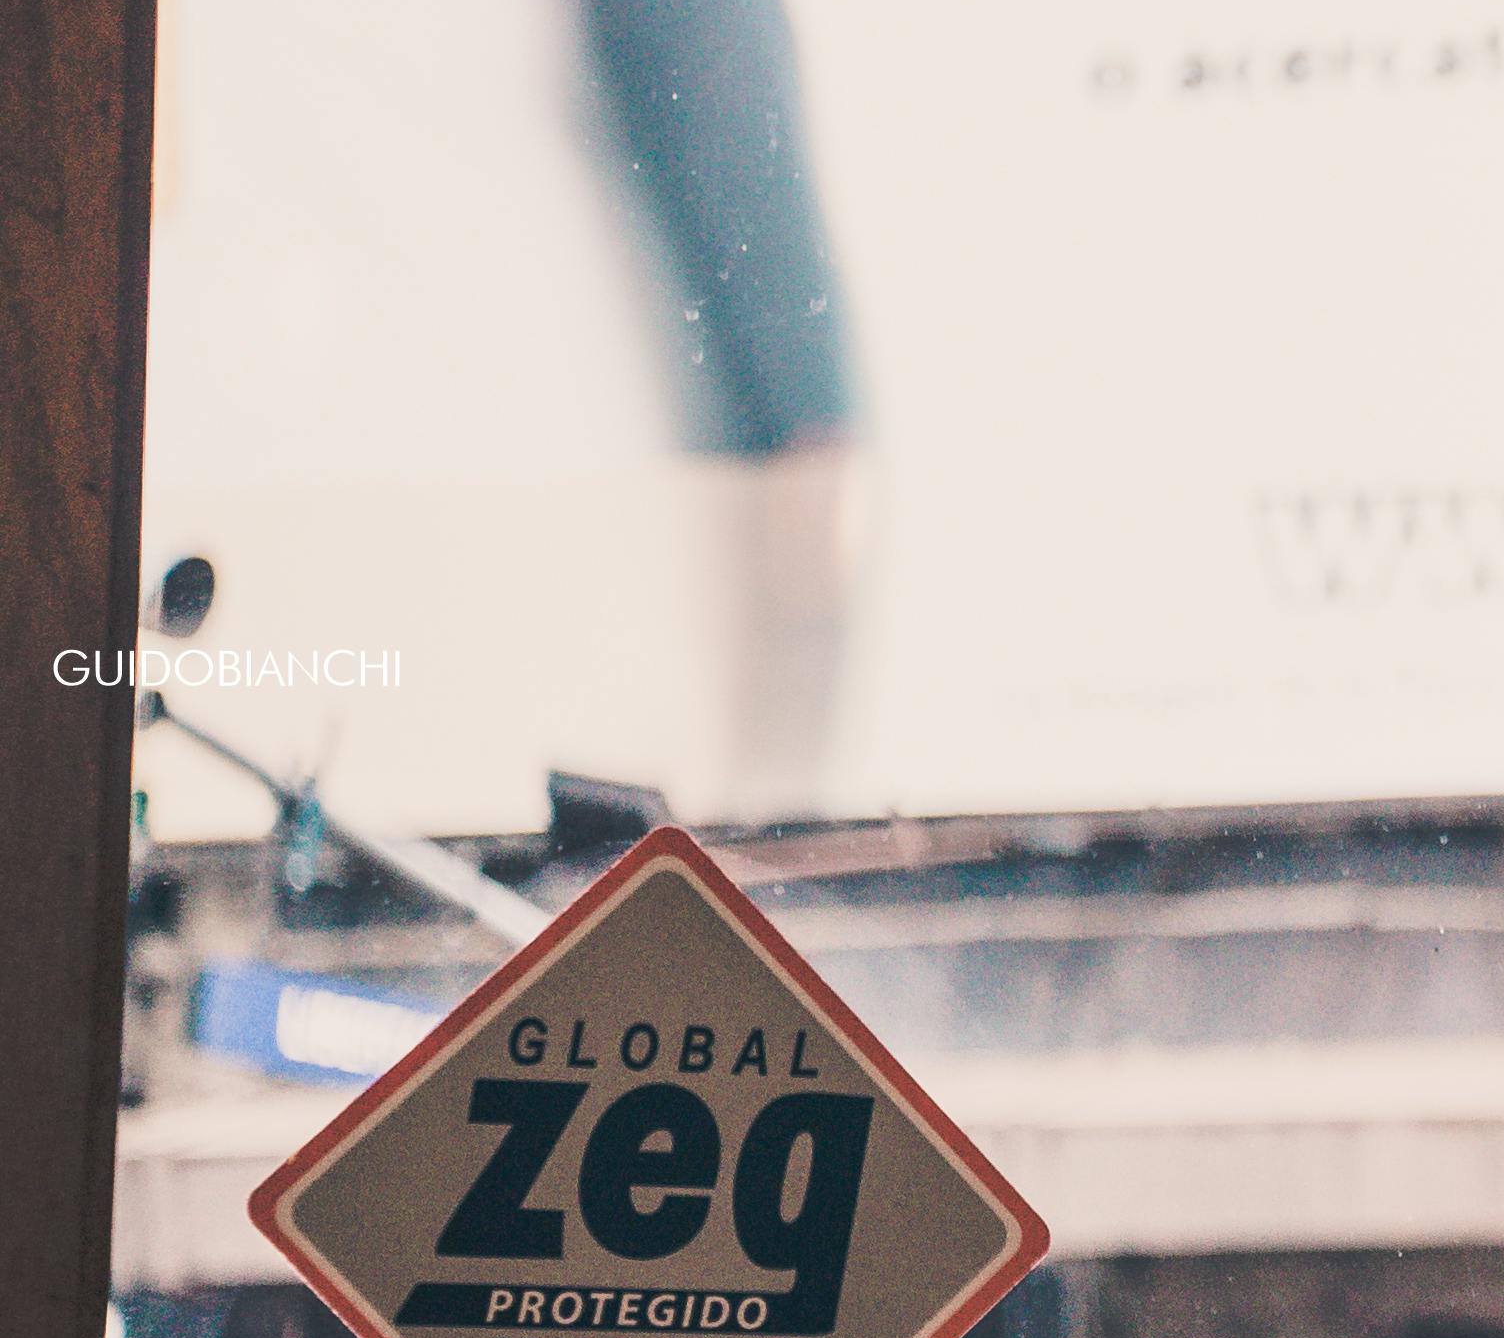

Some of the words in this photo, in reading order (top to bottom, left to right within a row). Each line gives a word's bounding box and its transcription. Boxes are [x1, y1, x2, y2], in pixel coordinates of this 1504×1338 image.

[507, 1015, 821, 1079] GLOBAL
[433, 1076, 877, 1335] zeg
[484, 1288, 770, 1331] PROTEGIDO
